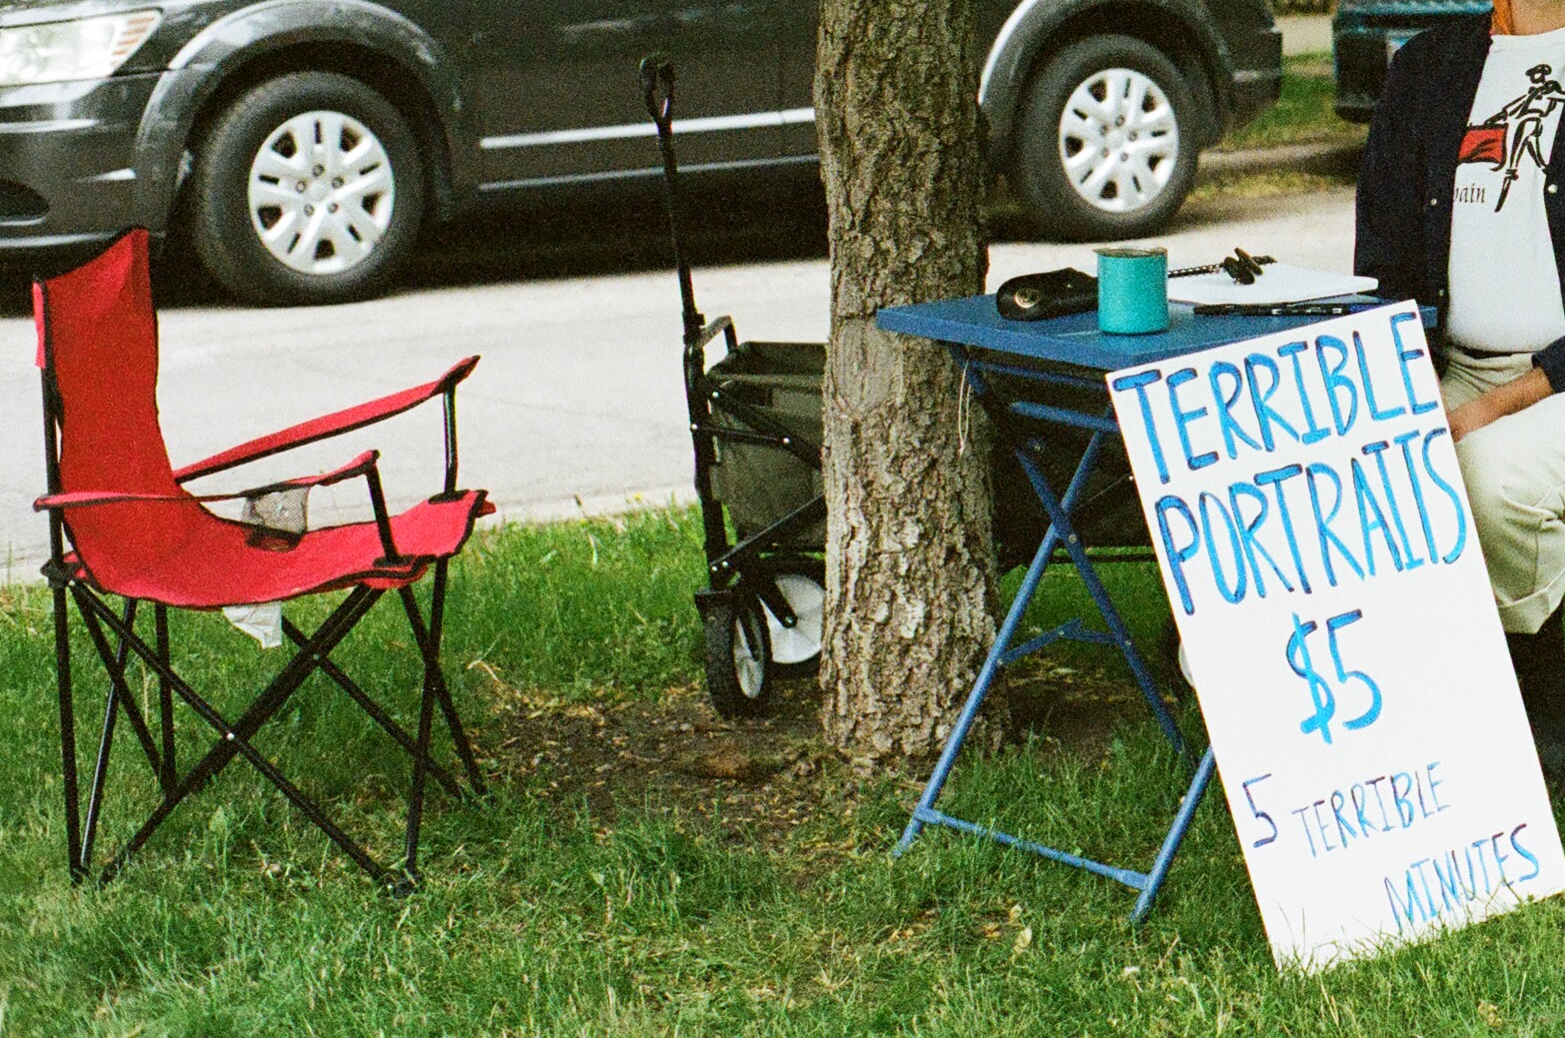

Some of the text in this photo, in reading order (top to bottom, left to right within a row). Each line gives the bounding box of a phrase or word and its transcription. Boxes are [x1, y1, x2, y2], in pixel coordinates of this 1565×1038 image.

[1112, 312, 1439, 484] TERRIBLE
[1155, 427, 1468, 616] PORTRAITS
[1286, 610, 1383, 745] $5
[1241, 761, 1451, 858] 5 TERRIBLE
[1383, 823, 1541, 928] MINUTES
